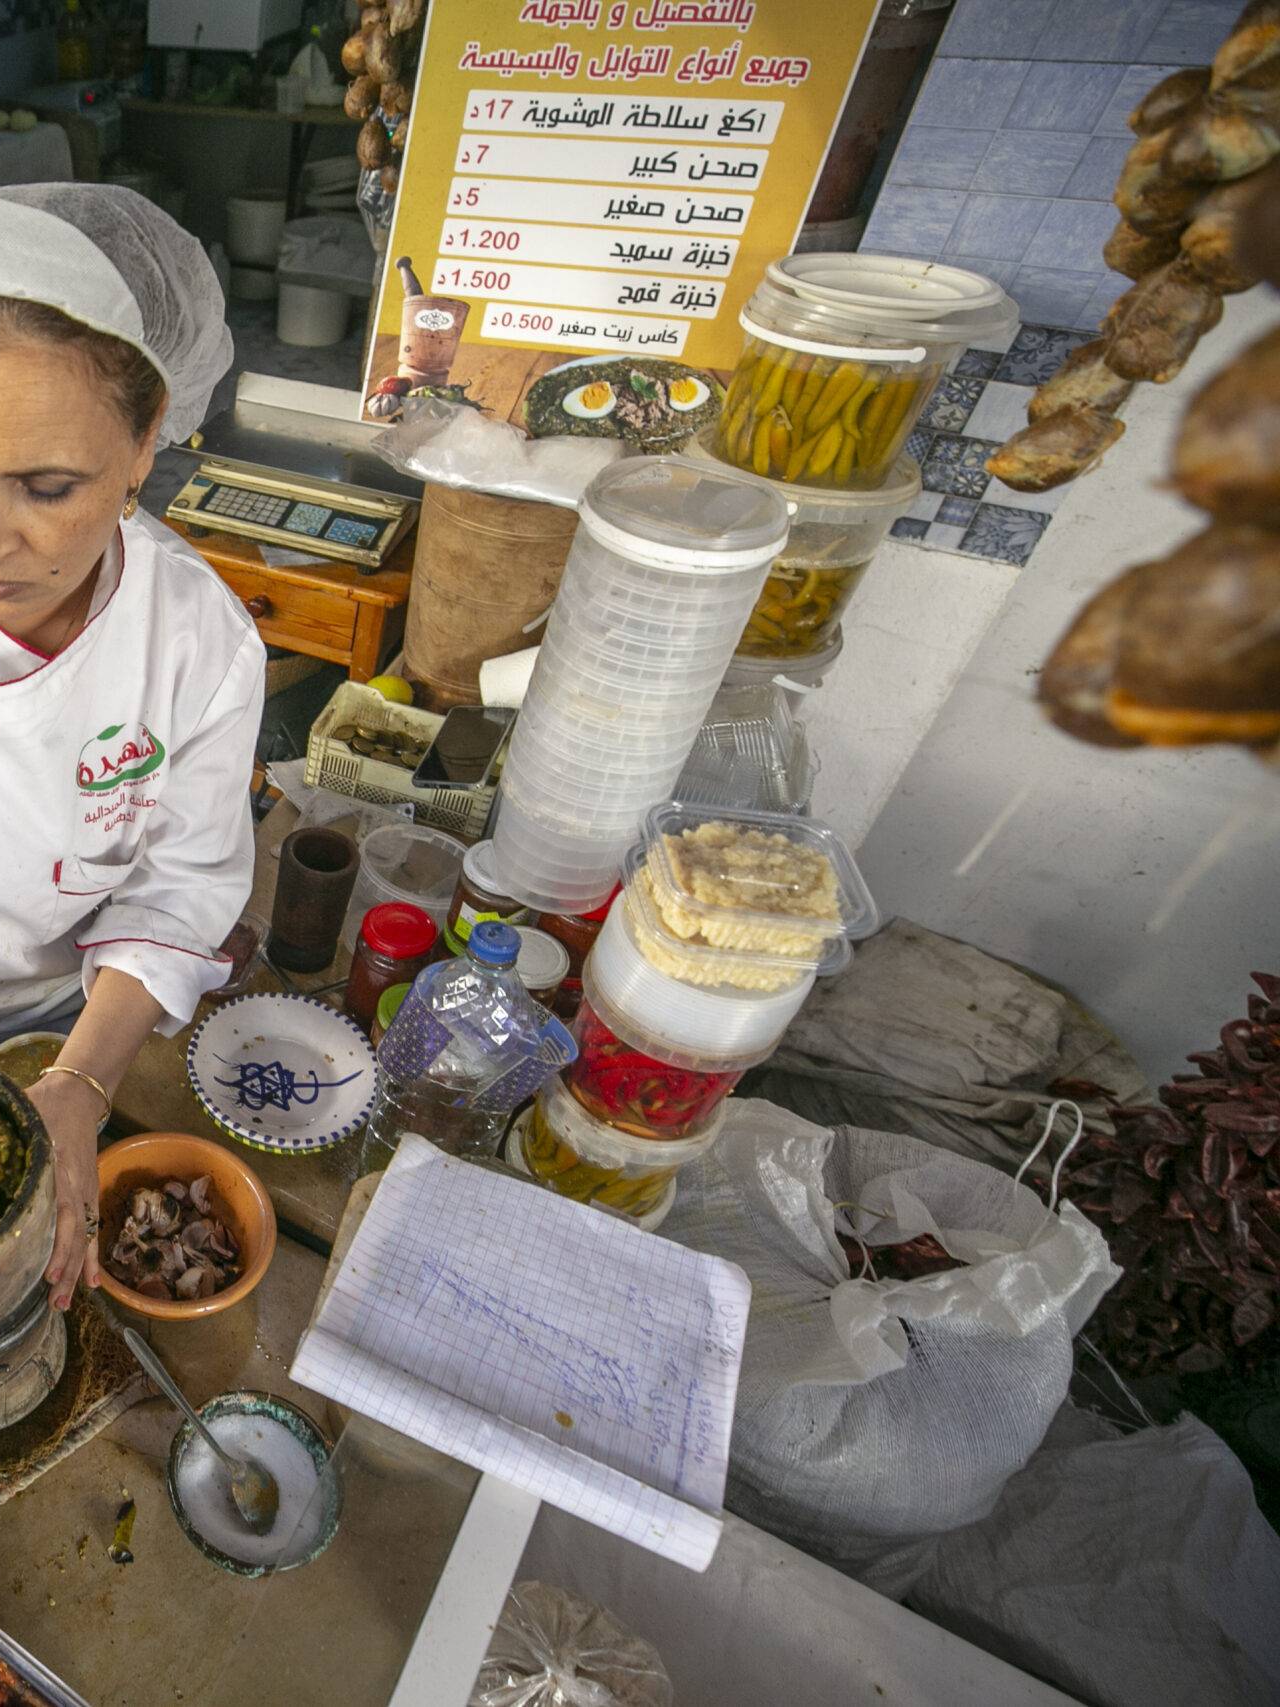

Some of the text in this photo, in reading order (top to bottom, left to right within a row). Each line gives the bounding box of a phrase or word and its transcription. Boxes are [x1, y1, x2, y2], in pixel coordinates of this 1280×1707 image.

[460, 42, 810, 86] جميع أنواع التوابل والبسيسة
[522, 97, 615, 128] المشوية
[623, 103, 708, 130] سلاطة
[476, 144, 489, 164] 7
[628, 151, 678, 178] كبير
[688, 153, 759, 180] صحن
[466, 187, 480, 206] 5
[604, 195, 665, 219] صغير
[675, 197, 744, 224] صحن
[460, 229, 520, 251] 1.200
[610, 241, 672, 264] سميد
[682, 240, 730, 269] خبزة
[451, 269, 511, 291] 1.500
[618, 283, 661, 304] قمح
[670, 281, 717, 310] خبزة
[501, 312, 553, 331] 0.500
[558, 323, 597, 337] صغير
[603, 325, 632, 342] زيت
[638, 325, 679, 344] كأس
